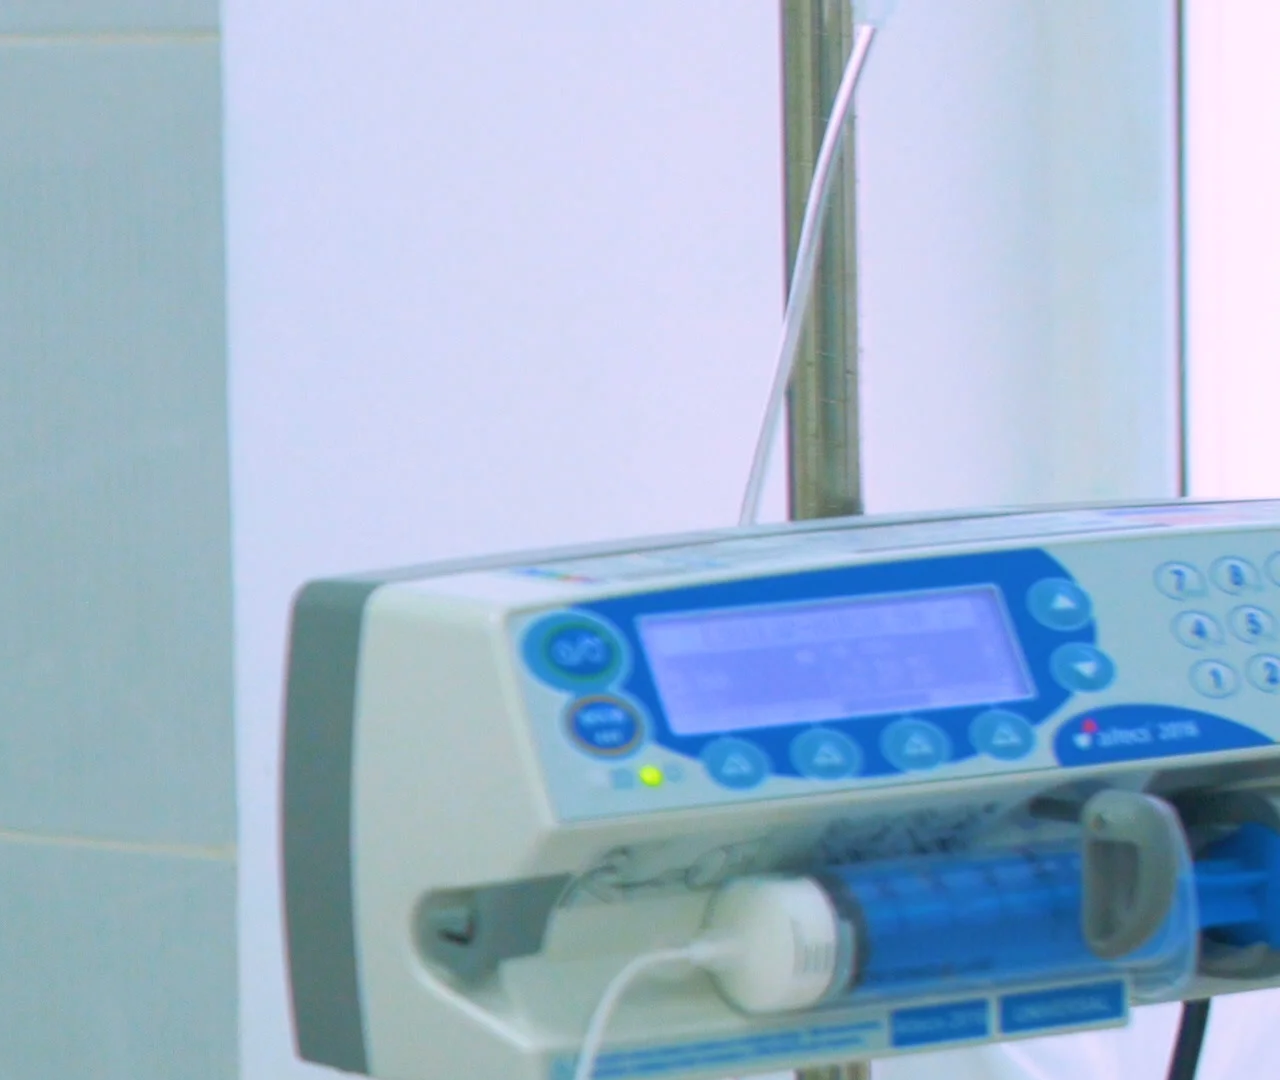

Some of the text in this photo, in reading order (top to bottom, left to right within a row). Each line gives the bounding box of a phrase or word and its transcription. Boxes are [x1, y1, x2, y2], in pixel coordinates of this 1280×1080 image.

[1170, 568, 1186, 592] 7
[1191, 612, 1263, 639] 4 5
[1263, 661, 1280, 686] 2
